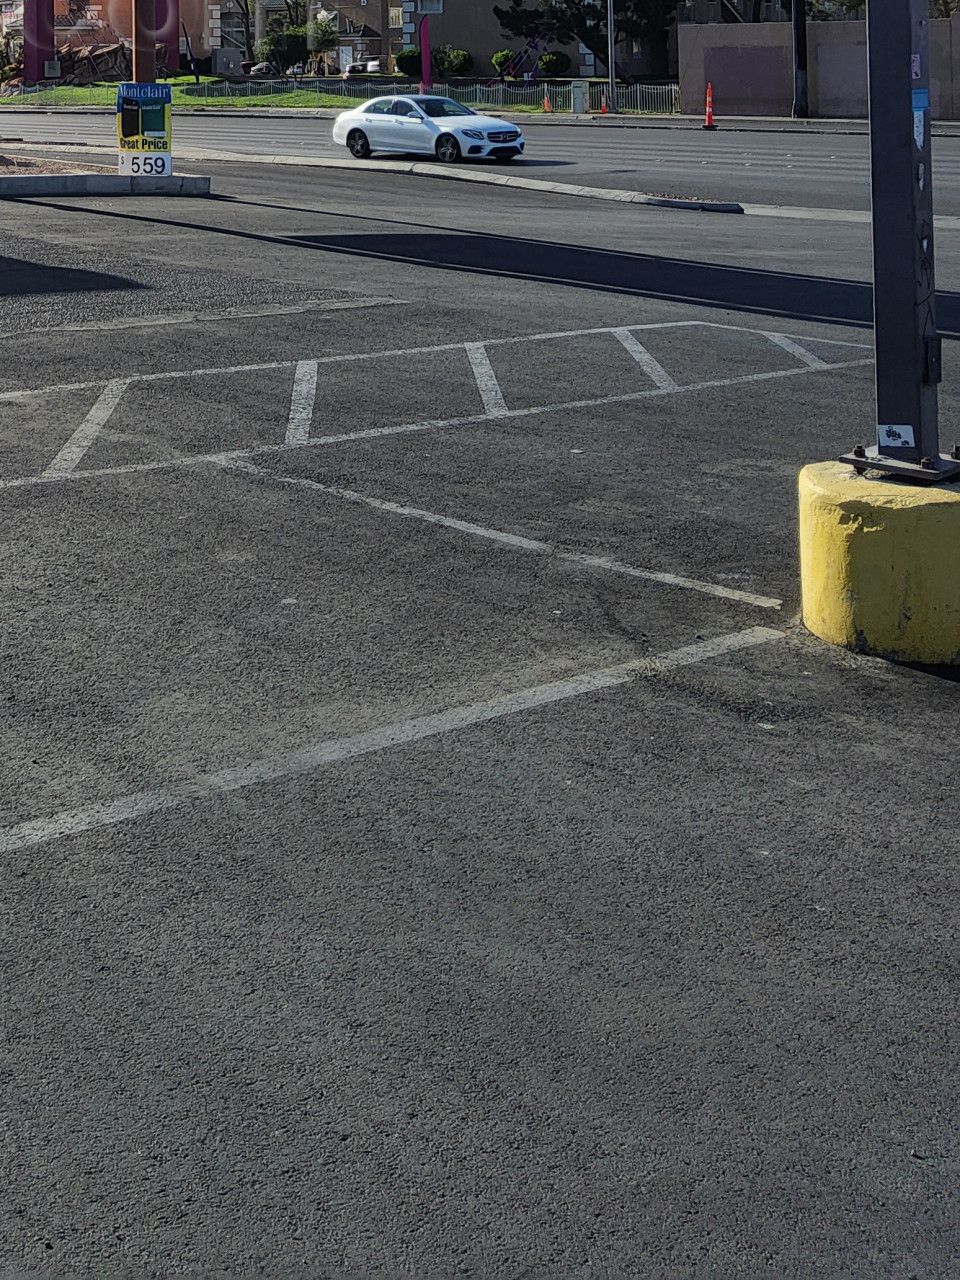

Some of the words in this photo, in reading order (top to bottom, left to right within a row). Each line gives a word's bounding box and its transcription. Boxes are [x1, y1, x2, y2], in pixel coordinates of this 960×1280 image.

[119, 85, 169, 98] Montclair
[120, 137, 140, 149] Great
[141, 138, 168, 150] Price
[120, 155, 125, 166] $
